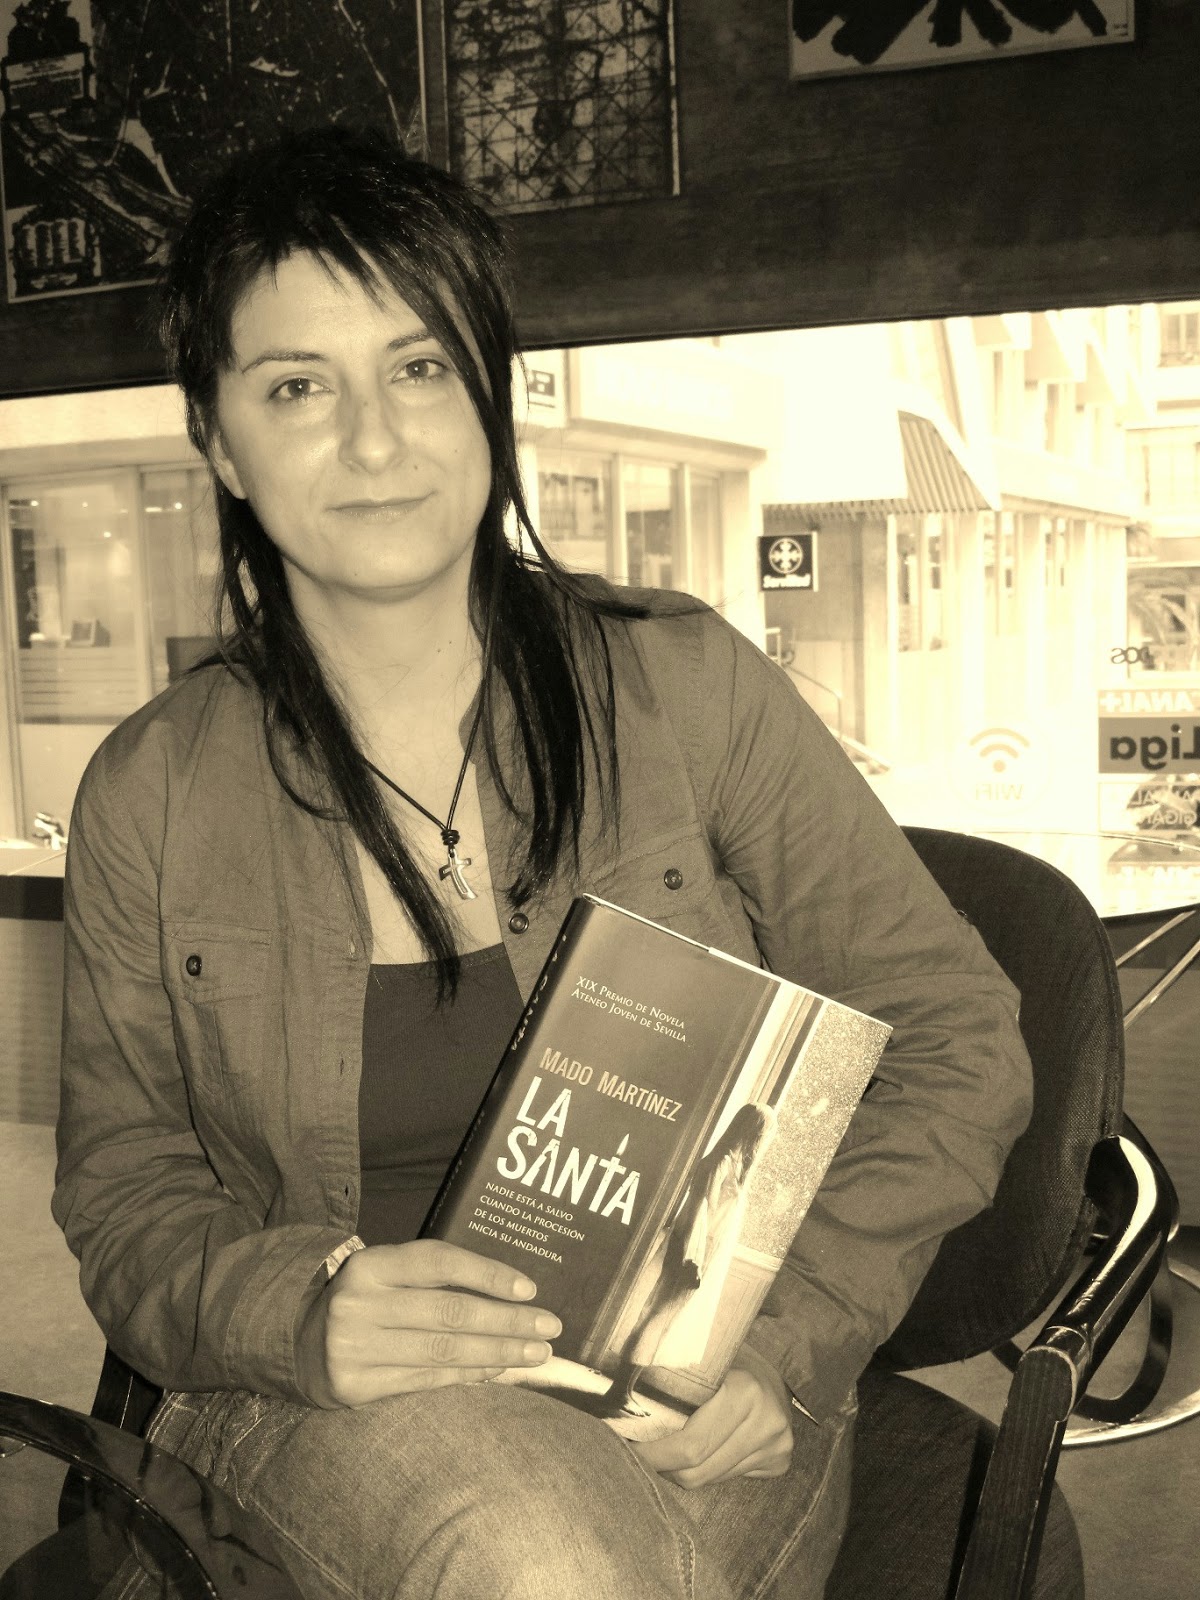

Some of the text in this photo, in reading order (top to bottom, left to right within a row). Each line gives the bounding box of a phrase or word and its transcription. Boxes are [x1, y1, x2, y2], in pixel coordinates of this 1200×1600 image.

[576, 976, 598, 992] XIX
[516, 1075, 572, 1137] LA
[539, 1047, 683, 1122] MADO MARTÍNEZ
[497, 1125, 641, 1225] SANTA
[480, 1195, 585, 1241] CUANDO LA PROCESIÓN
[485, 1182, 573, 1221] NADIE ESTÁ A SALVO
[468, 1221, 562, 1263] INICIA SU ANDADURA
[474, 1208, 549, 1242] DE LOS MUERTOS
